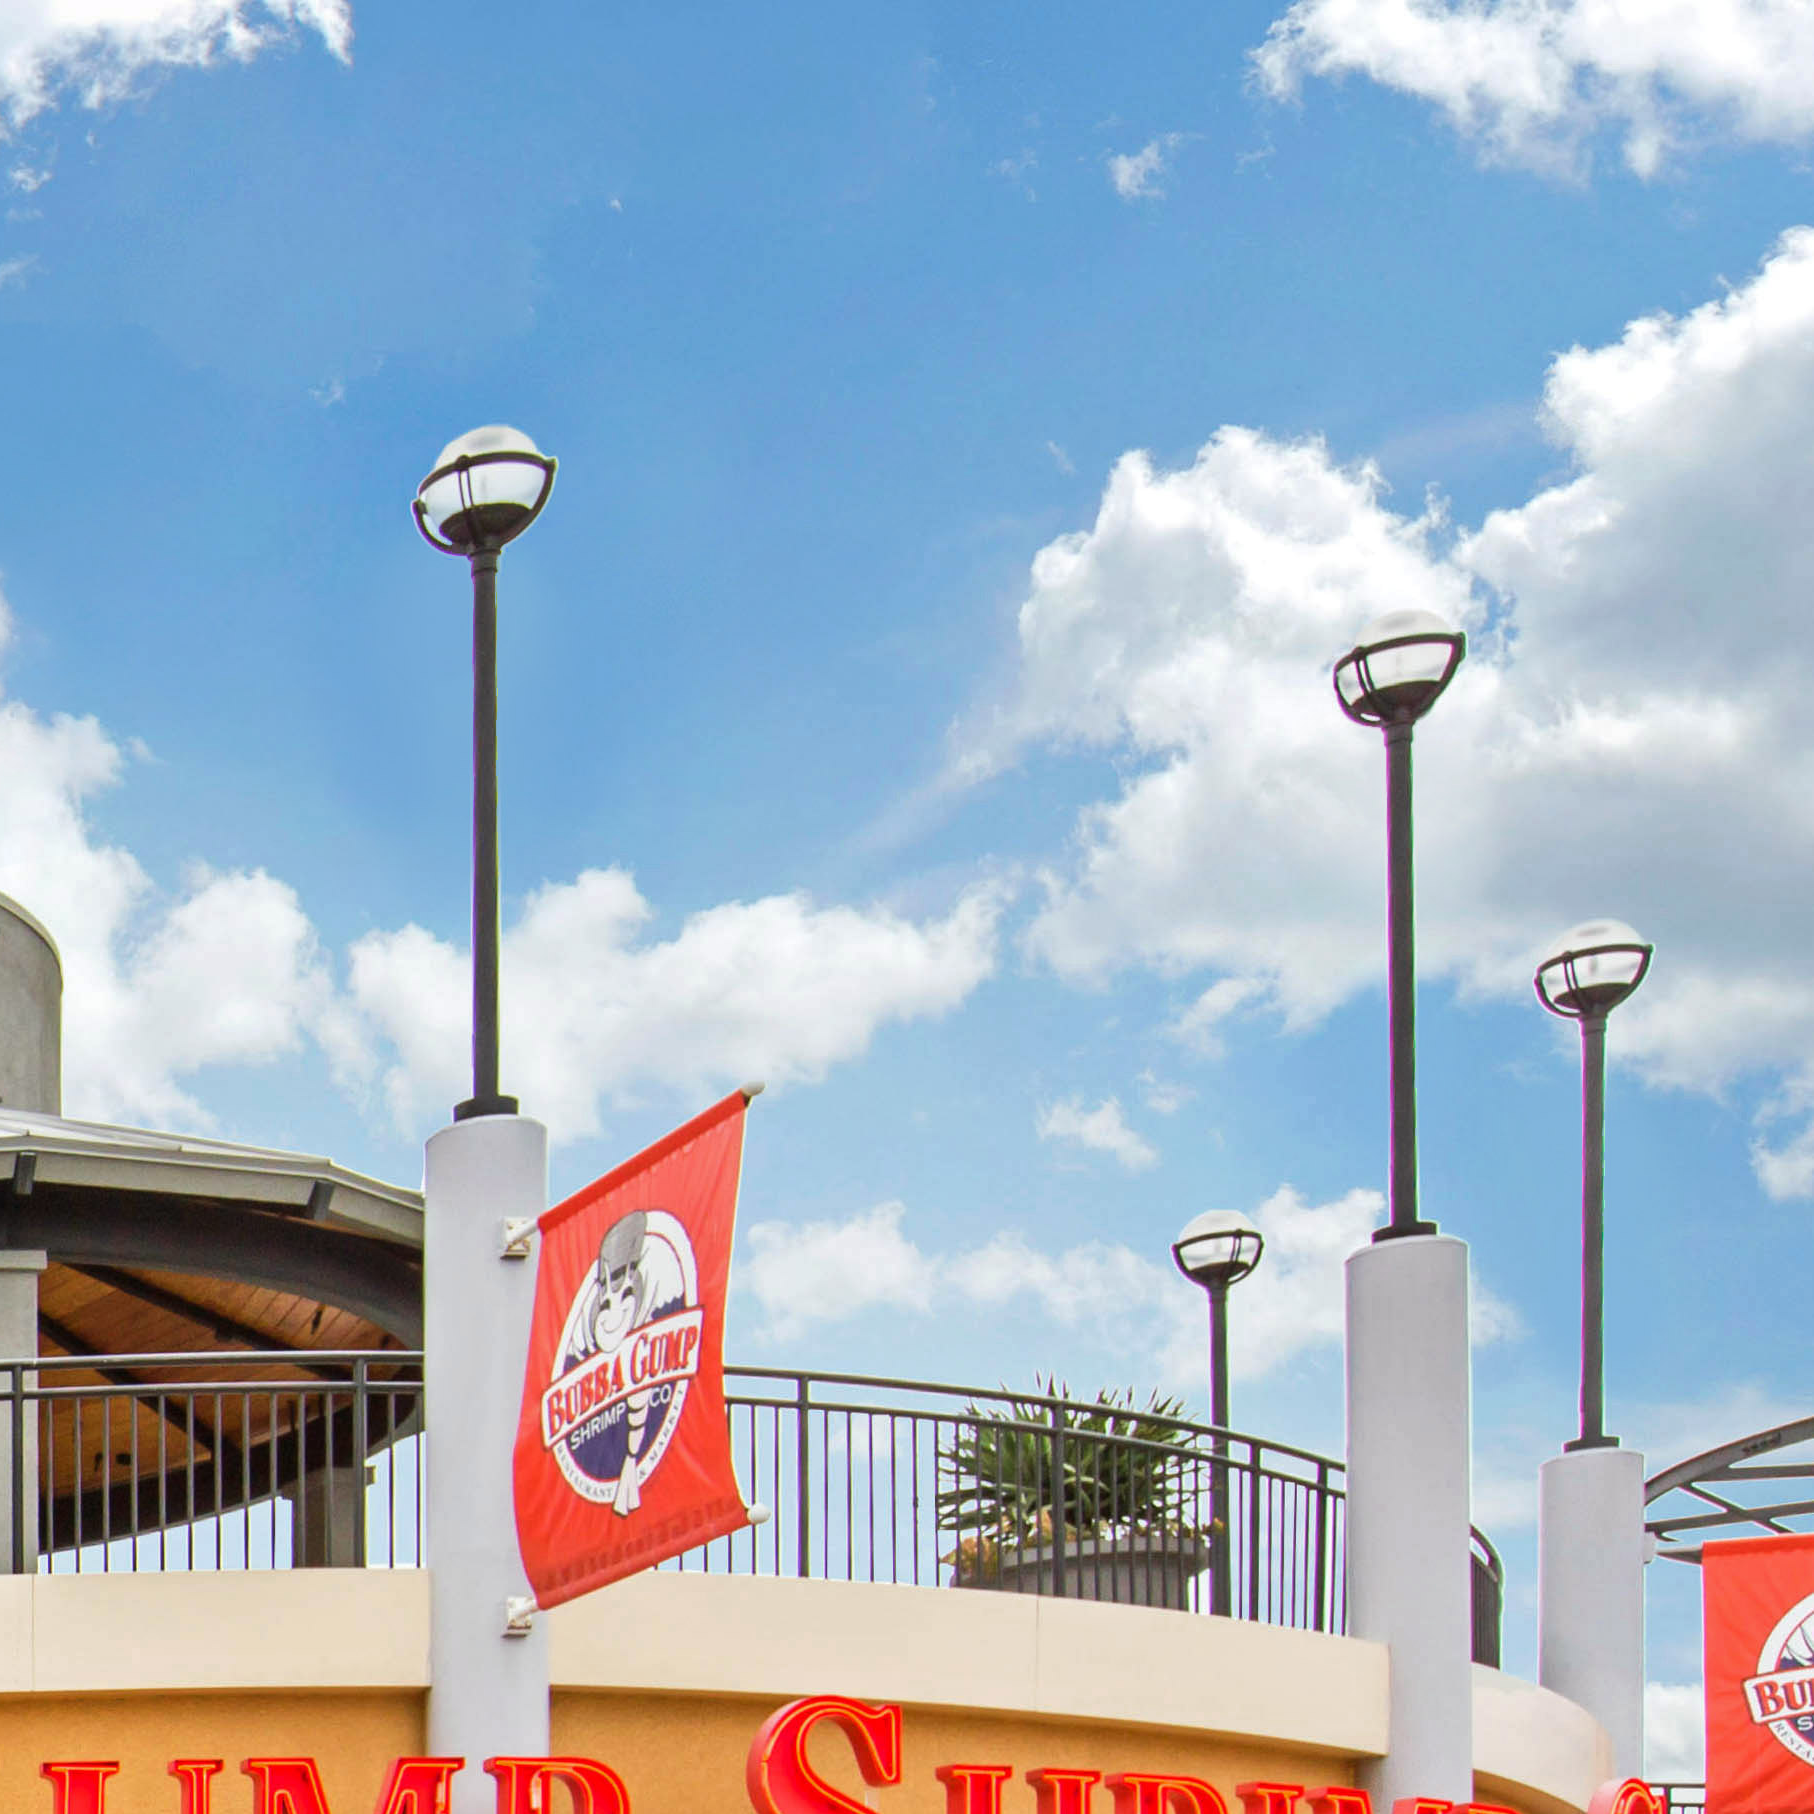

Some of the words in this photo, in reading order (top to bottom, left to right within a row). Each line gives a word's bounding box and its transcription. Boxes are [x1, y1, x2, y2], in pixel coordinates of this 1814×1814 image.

[547, 1353, 625, 1440] BUBBA
[630, 1325, 698, 1385] GUMP
[570, 1402, 627, 1450] SHRIMP
[557, 1444, 614, 1498] RESTAURANT
